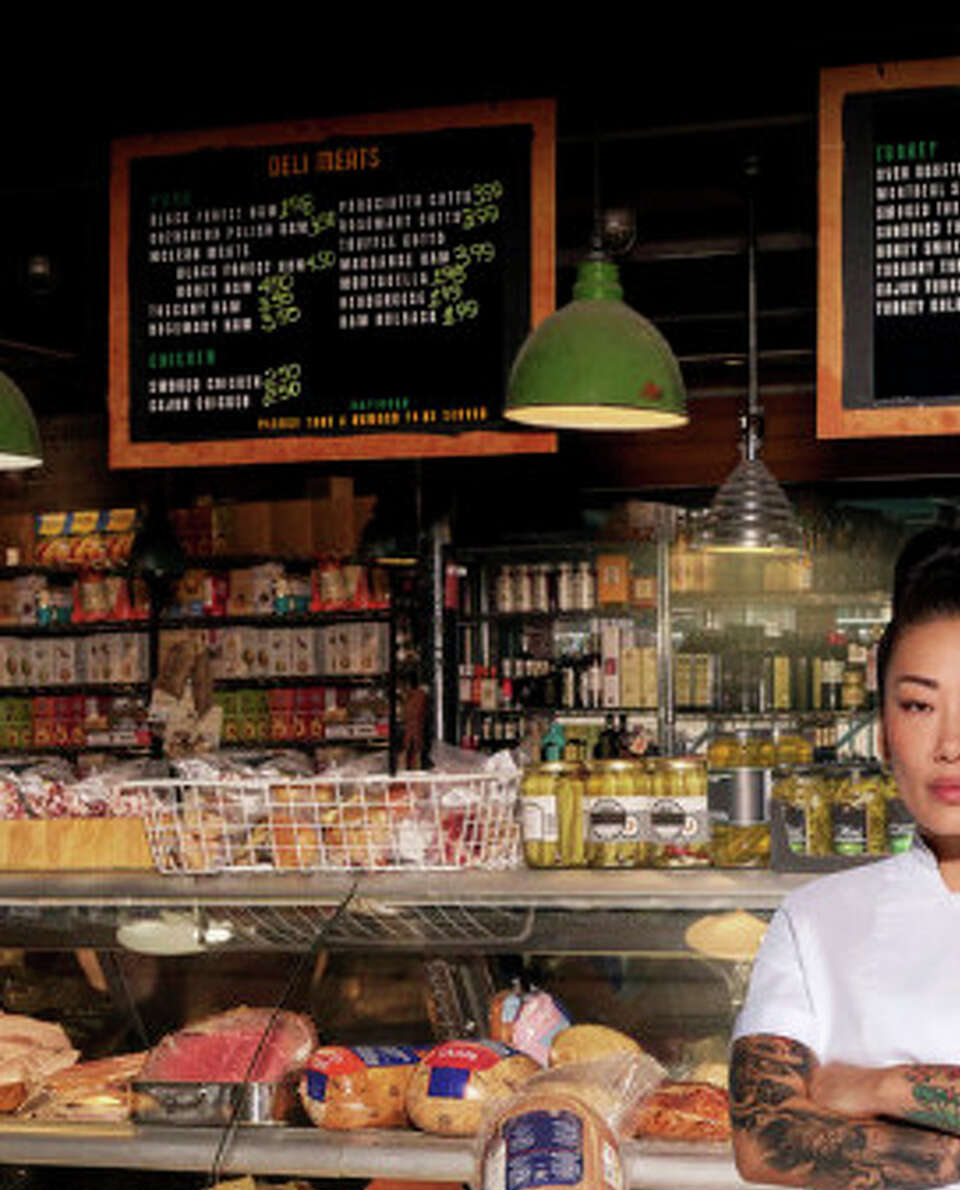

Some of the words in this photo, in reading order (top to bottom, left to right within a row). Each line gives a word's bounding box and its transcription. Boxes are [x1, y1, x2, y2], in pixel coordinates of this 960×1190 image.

[876, 140, 936, 162] TURKEY
[269, 152, 308, 177] DELI
[315, 147, 381, 172] MEATS
[876, 165, 910, 182] OVEN
[876, 202, 931, 221] SMOKED
[876, 281, 918, 298] CAJUN
[876, 299, 925, 317] TURKEY
[148, 349, 217, 369] CHICKEN
[147, 377, 201, 394] SMOKED
[206, 373, 261, 391] CHICKEN
[147, 396, 192, 413] CAJUN
[195, 394, 250, 412] CHICKEN
